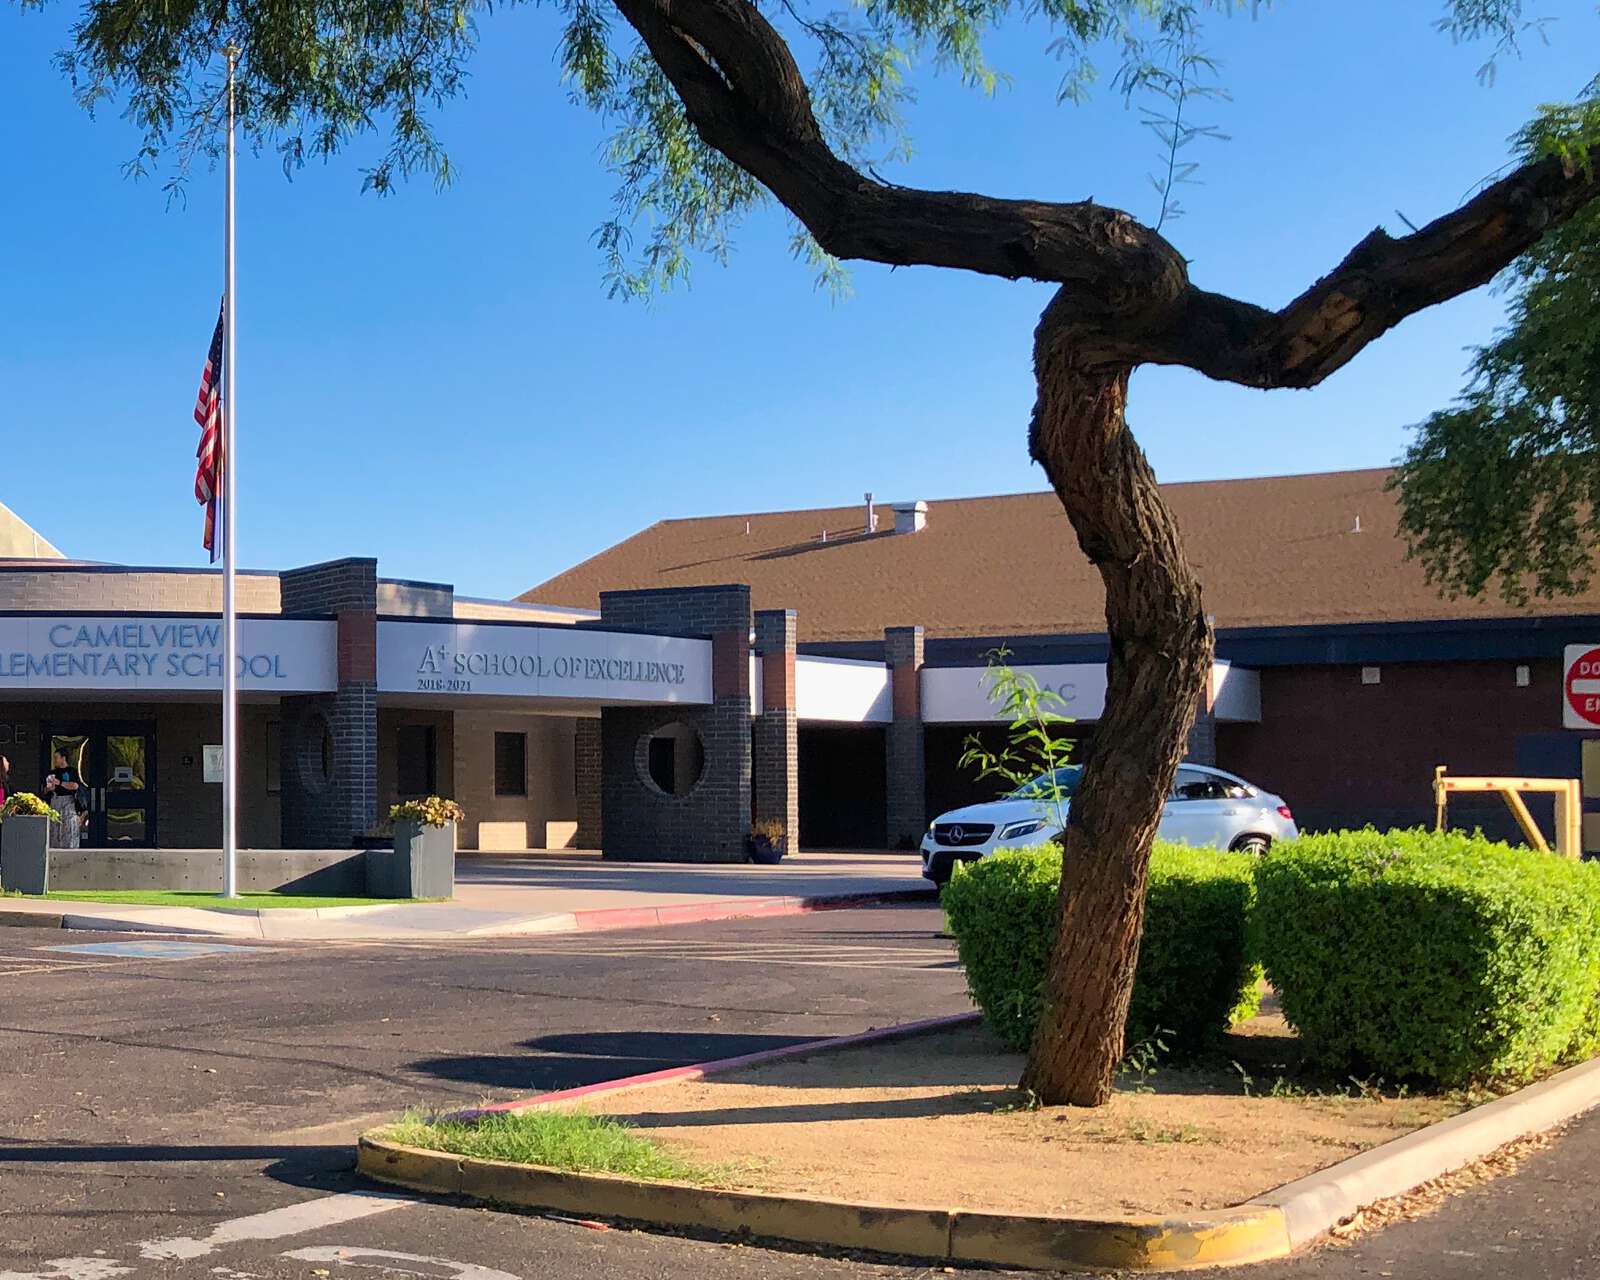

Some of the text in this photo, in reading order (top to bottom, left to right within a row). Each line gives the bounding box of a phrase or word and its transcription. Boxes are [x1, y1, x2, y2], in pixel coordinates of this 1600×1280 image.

[49, 624, 220, 649] CAMELVIEW
[454, 652, 550, 677] SCHOOL
[554, 656, 581, 679] OF
[584, 658, 684, 685] EXCELLENCE
